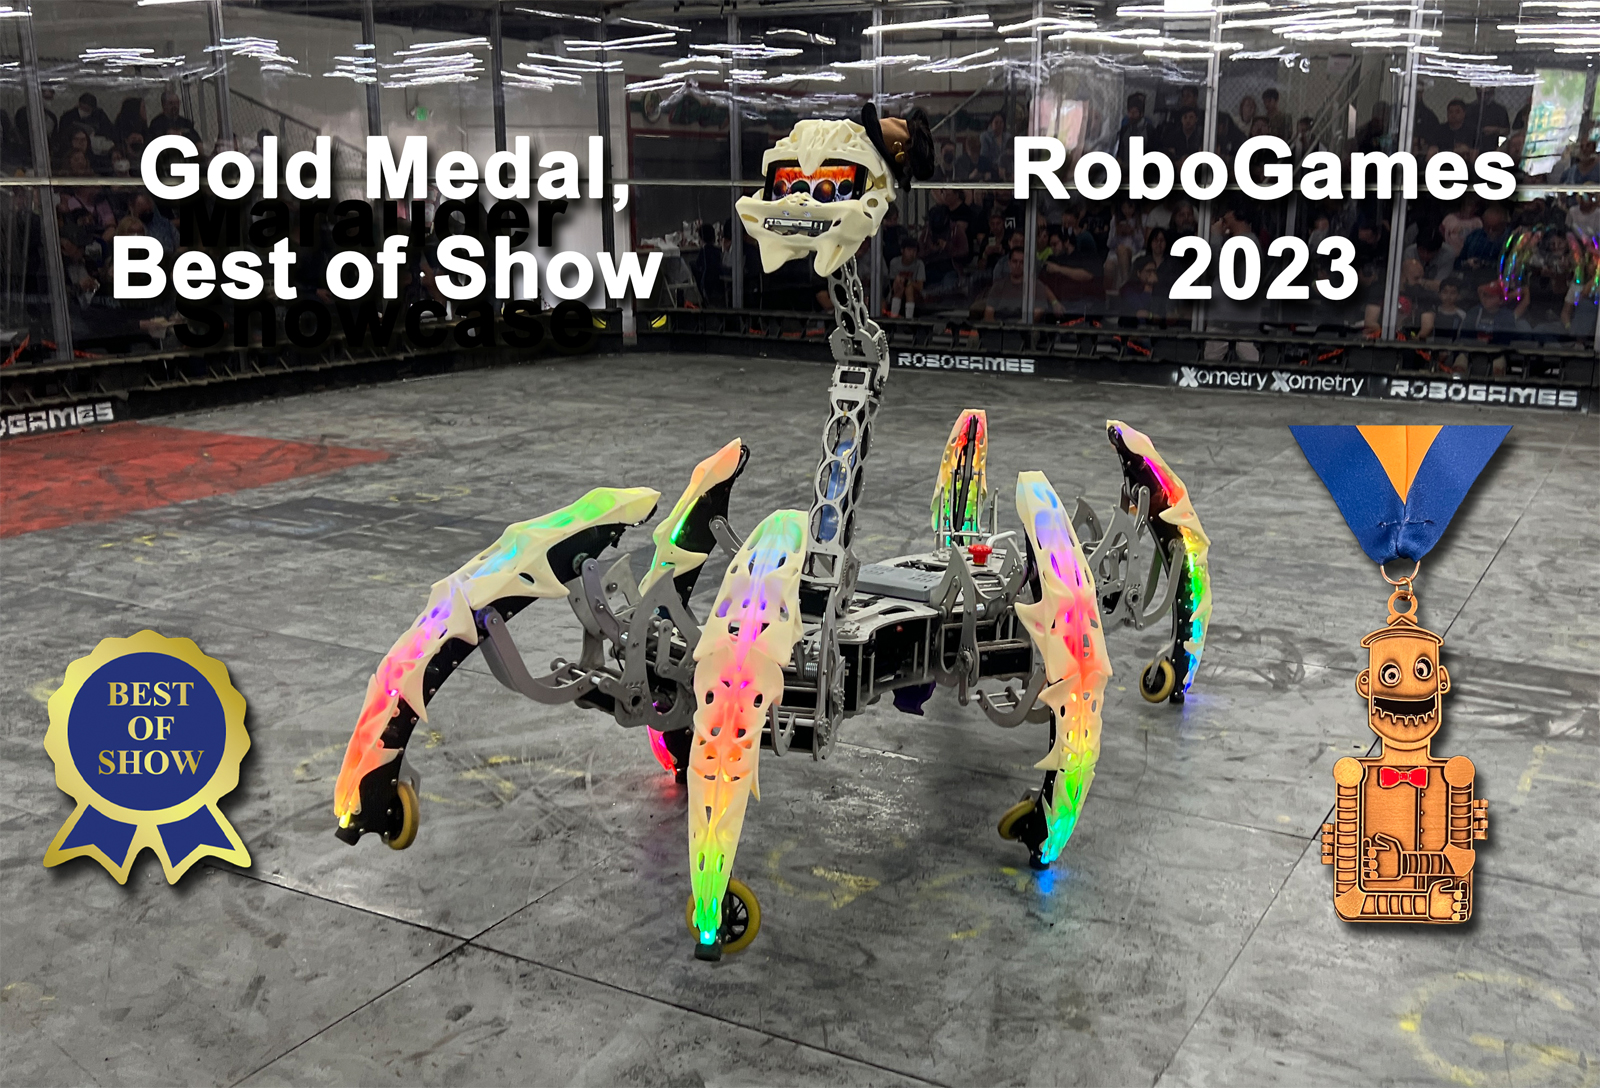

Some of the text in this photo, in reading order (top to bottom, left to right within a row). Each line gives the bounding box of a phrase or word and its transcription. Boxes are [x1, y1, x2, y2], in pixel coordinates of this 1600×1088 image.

[898, 352, 1036, 373] ROBOGAMES
[1178, 365, 1365, 396] Xometry Xometry
[1390, 378, 1579, 407] ROBOGAMES
